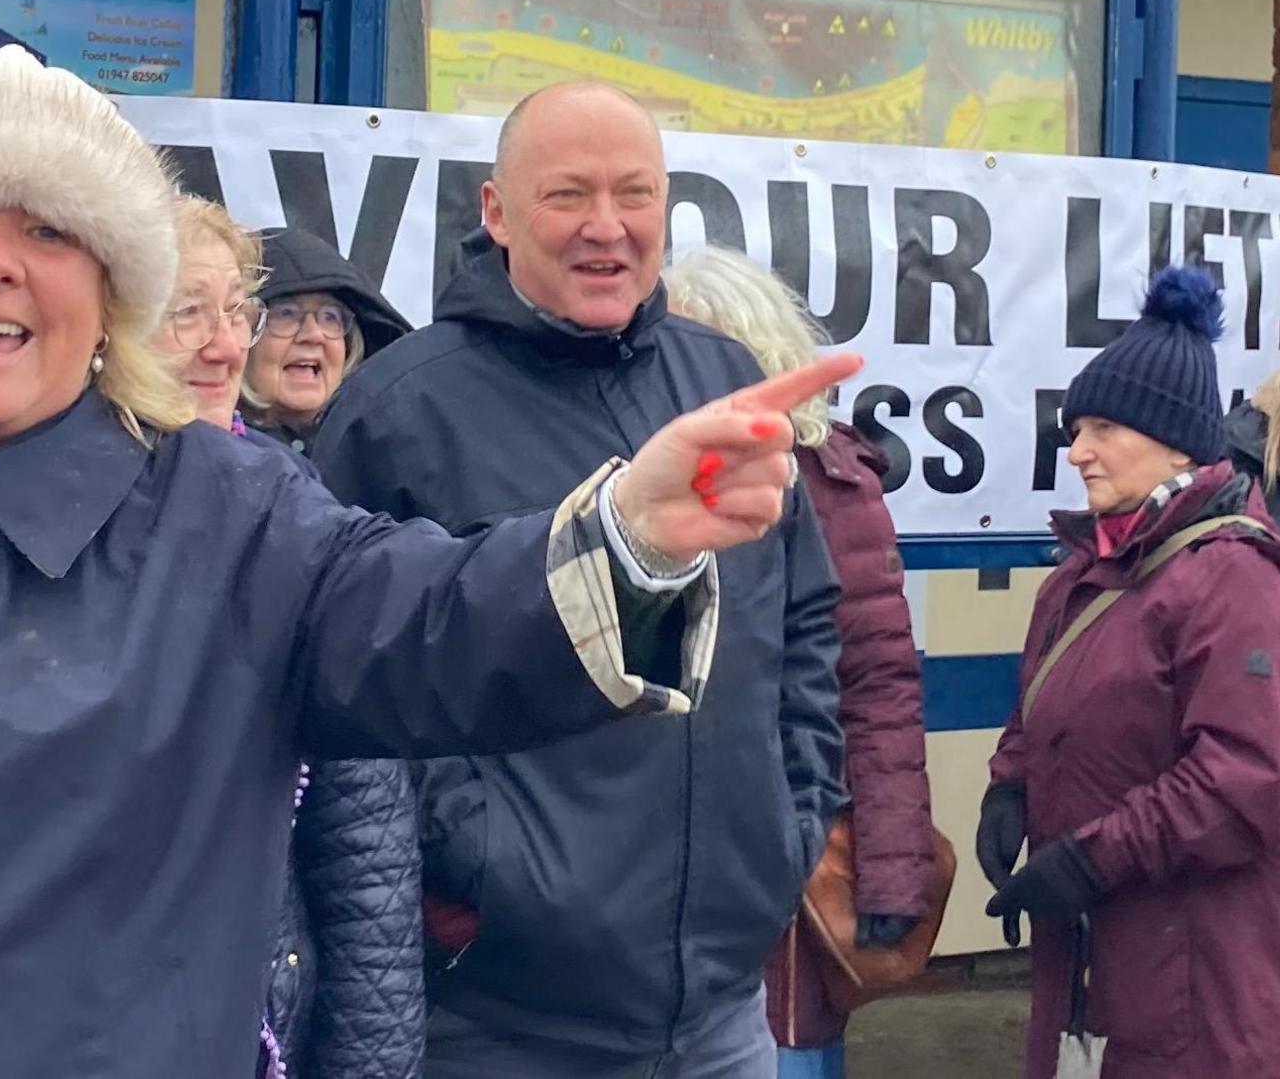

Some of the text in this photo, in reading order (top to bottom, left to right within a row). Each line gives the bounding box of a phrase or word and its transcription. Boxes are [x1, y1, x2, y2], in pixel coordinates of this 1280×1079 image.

[965, 16, 1054, 53] Whitby
[81, 50, 107, 61] Food
[109, 51, 137, 62] Menu
[98, 68, 130, 80] 01947
